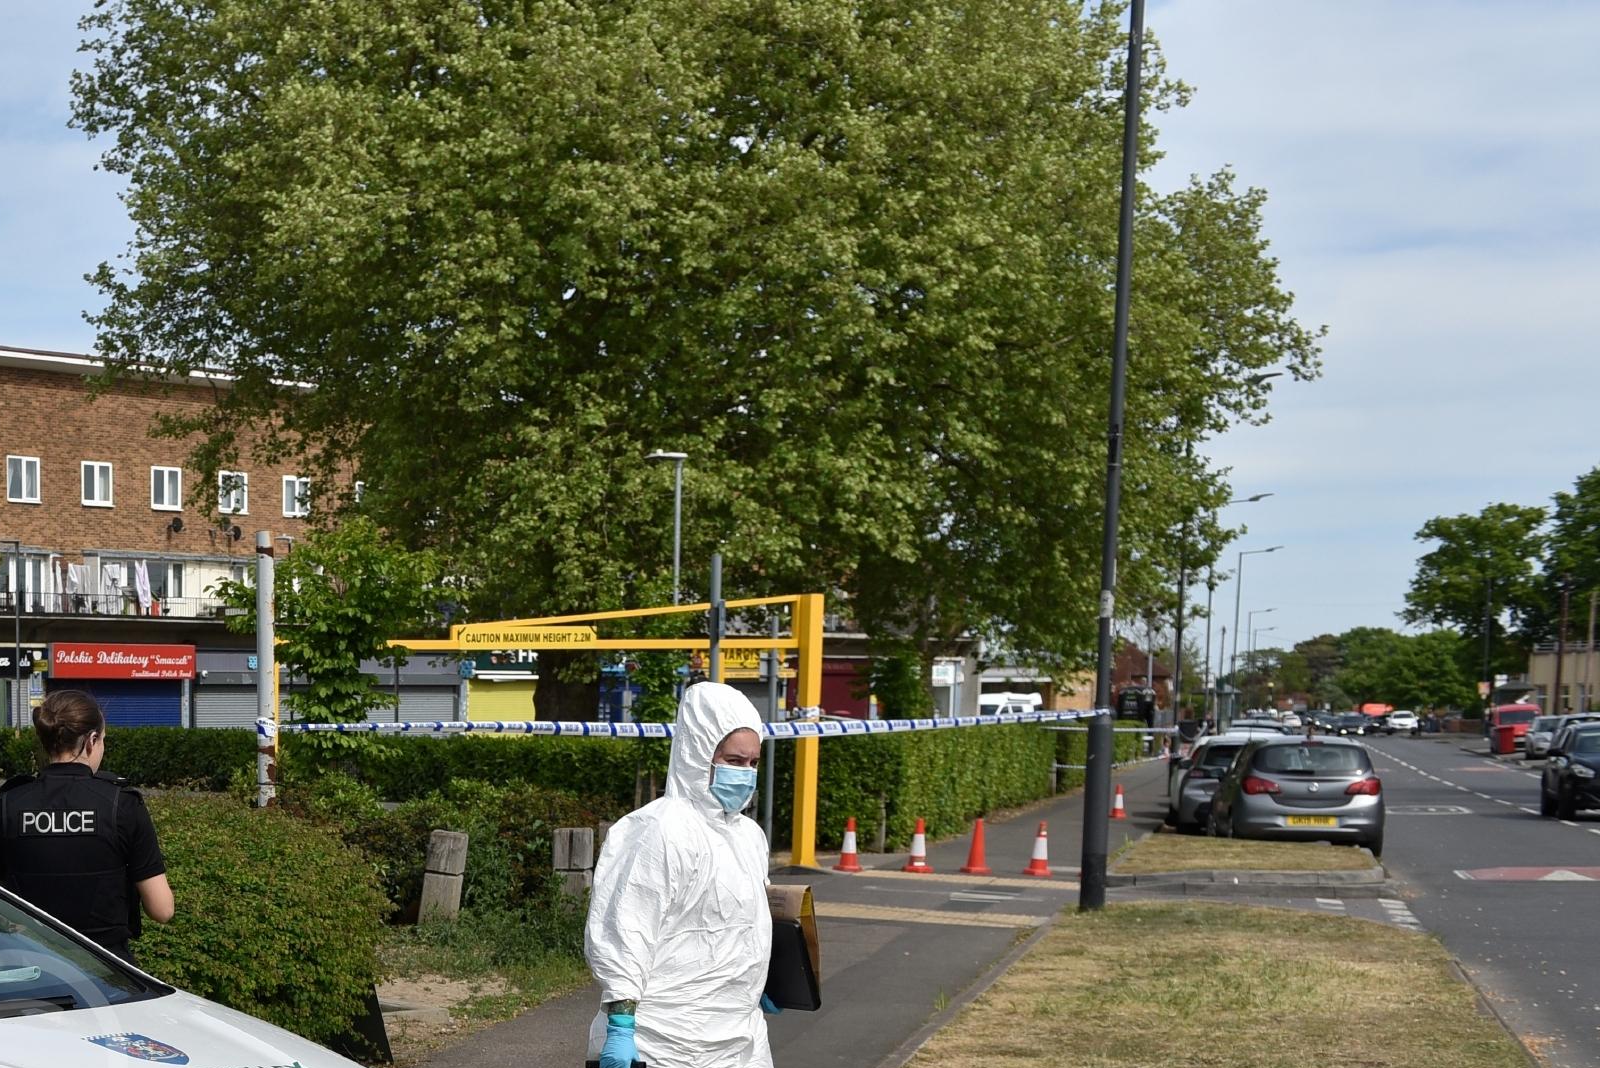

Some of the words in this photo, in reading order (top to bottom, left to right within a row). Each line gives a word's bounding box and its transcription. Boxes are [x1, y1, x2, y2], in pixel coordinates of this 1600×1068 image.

[465, 633, 500, 643] CAUTION
[503, 633, 541, 643] MAXIMUM
[543, 632, 571, 643] HEIGHT
[574, 632, 591, 642] 2.2M
[56, 650, 93, 664] Polskie
[97, 651, 149, 668] Delikatesy
[22, 810, 95, 834] POLICE
